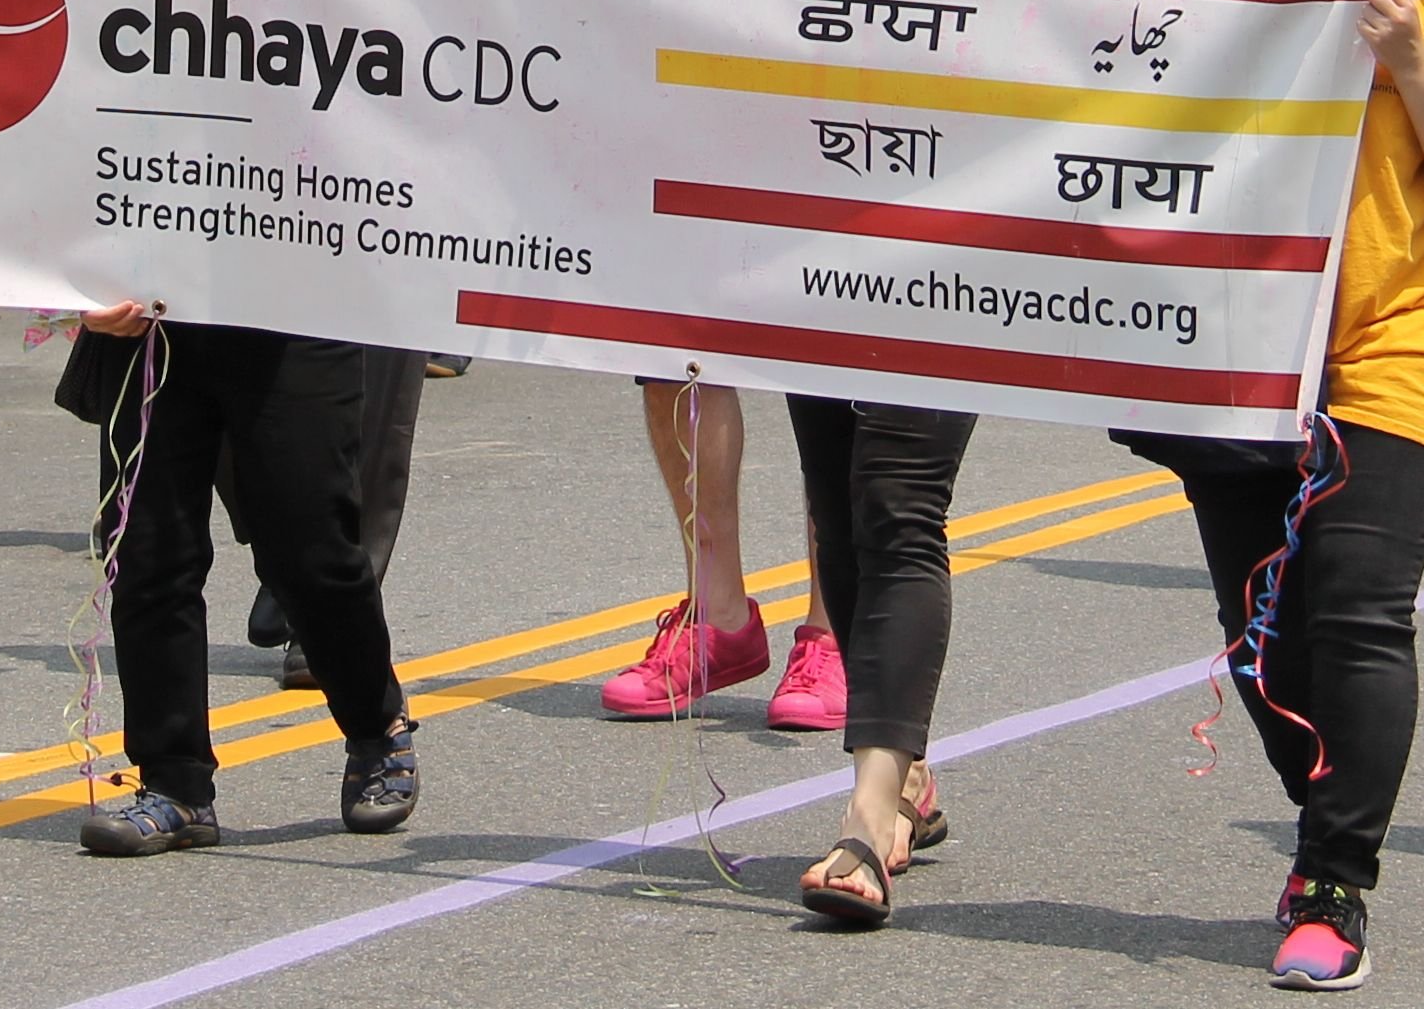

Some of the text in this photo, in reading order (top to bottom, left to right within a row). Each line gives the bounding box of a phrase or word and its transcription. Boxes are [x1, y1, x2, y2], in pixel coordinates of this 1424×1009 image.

[423, 35, 561, 112] CDC
[96, 147, 414, 209] Sustaining Homes
[810, 118, 943, 180] ছায়া
[1054, 153, 1214, 214] छाया
[95, 194, 593, 276] Strengthening Communities
[802, 267, 1198, 345] www.chhayacdc.org
